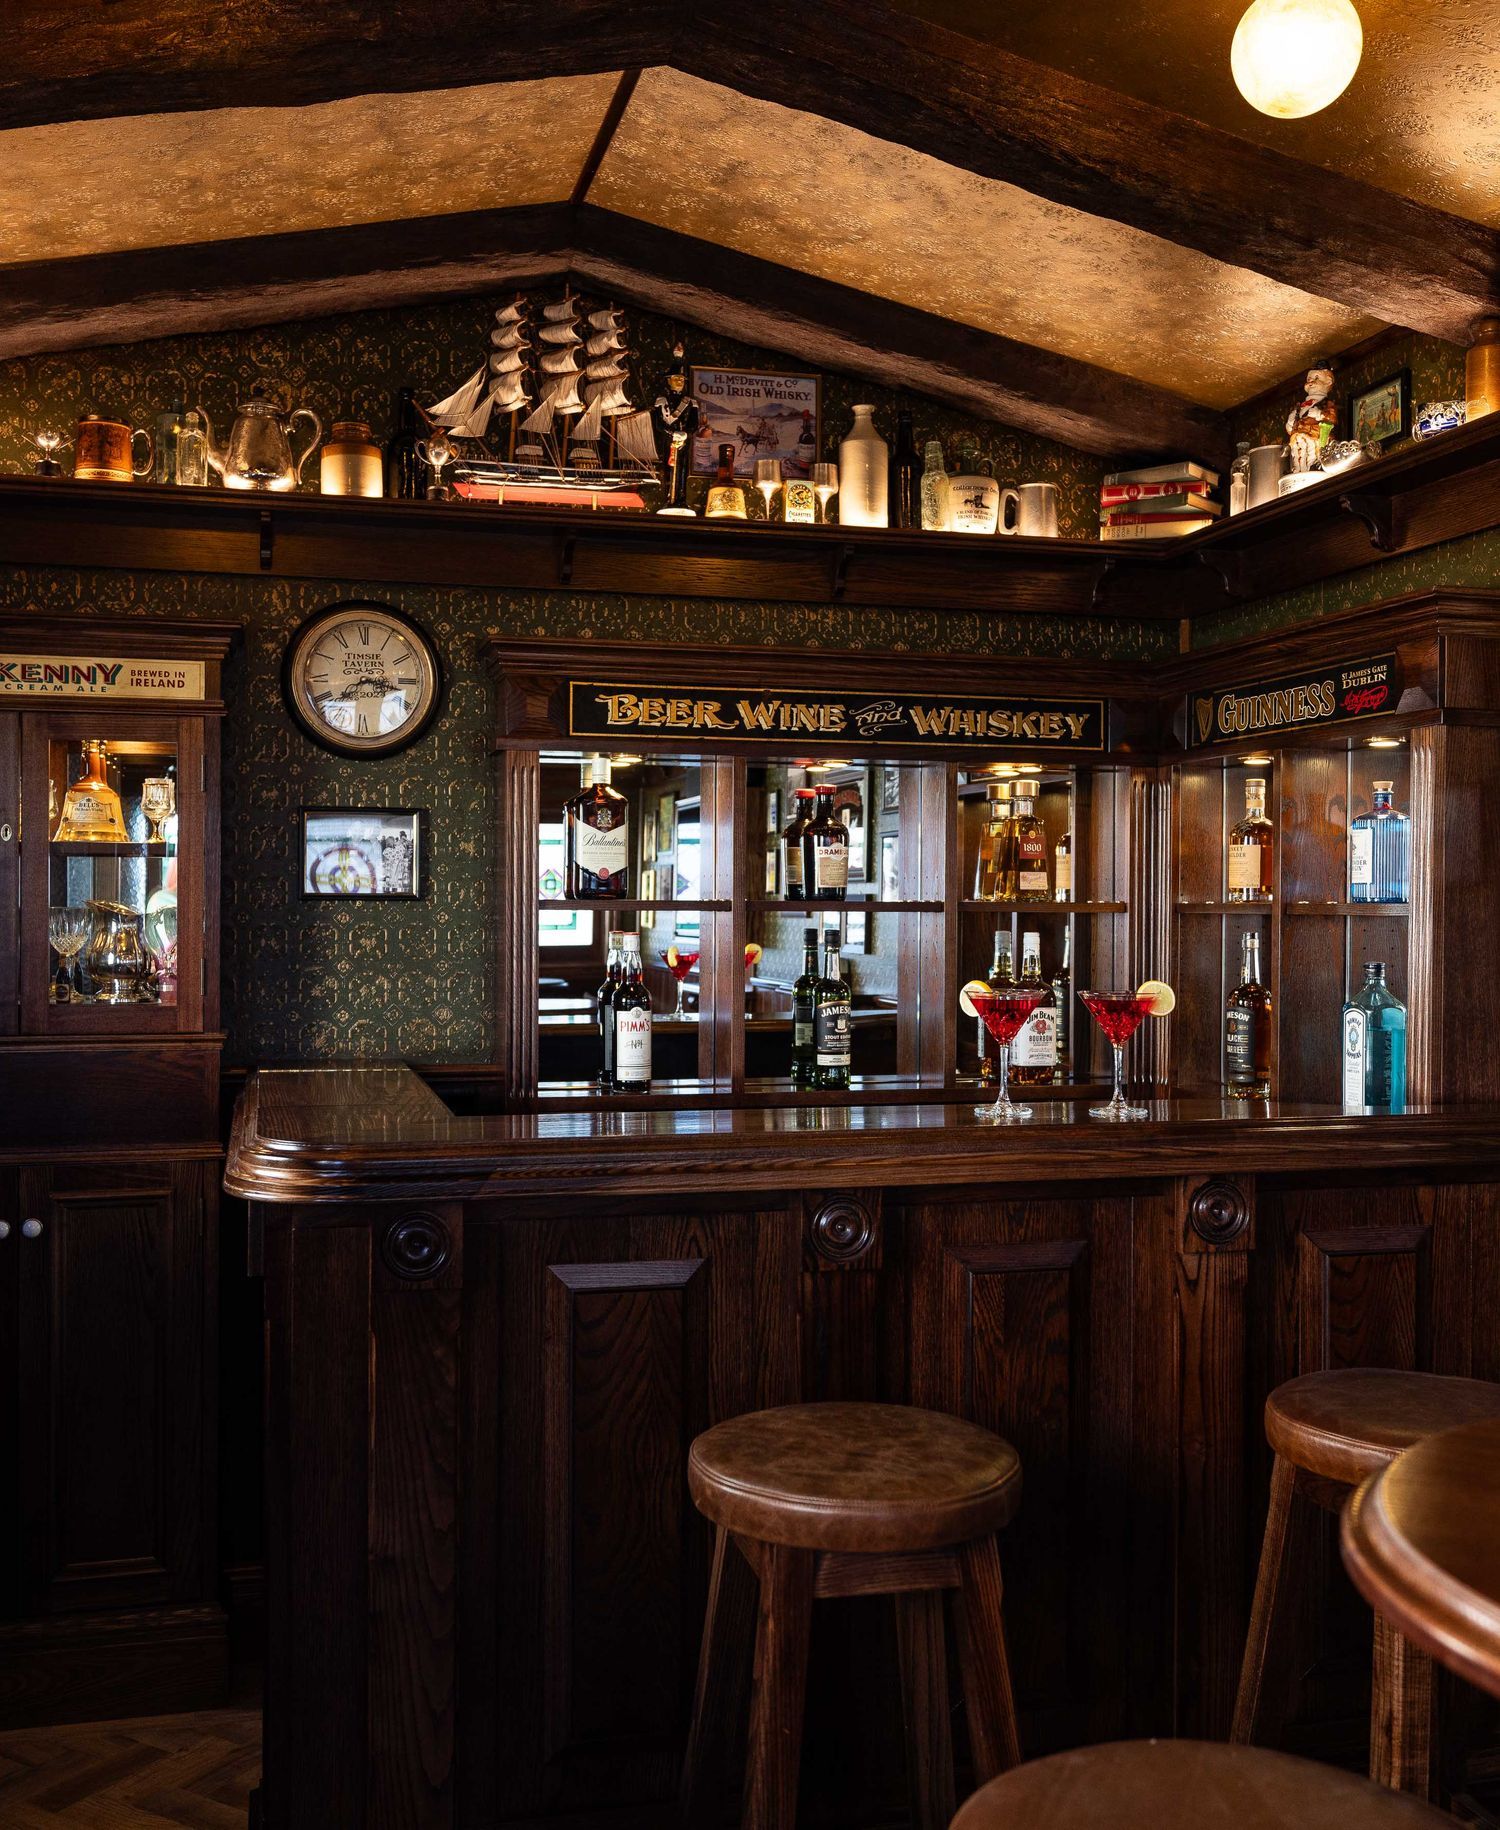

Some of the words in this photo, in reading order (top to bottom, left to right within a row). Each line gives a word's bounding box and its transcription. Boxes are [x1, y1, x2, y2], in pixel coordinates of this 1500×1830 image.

[698, 382, 725, 395] OLD
[727, 385, 761, 398] IRISH
[344, 652, 382, 660] TIMSIE
[342, 660, 384, 668] TAVERN
[1371, 665, 1388, 673] GATE
[130, 669, 170, 678] BREWED
[174, 671, 186, 679] IN
[130, 678, 186, 688] IRELAND
[1342, 672, 1387, 689] DUBLIN
[4, 683, 64, 691] CREAM
[1218, 680, 1336, 734] GUINNESS
[595, 693, 740, 730] BEER
[736, 700, 849, 732] WINE
[909, 705, 1090, 740] WHISKEY
[1023, 843, 1042, 852] 1800
[1026, 1013, 1039, 1024] JIM
[1039, 1010, 1055, 1024] BEAM
[620, 1019, 651, 1032] PIMM'S
